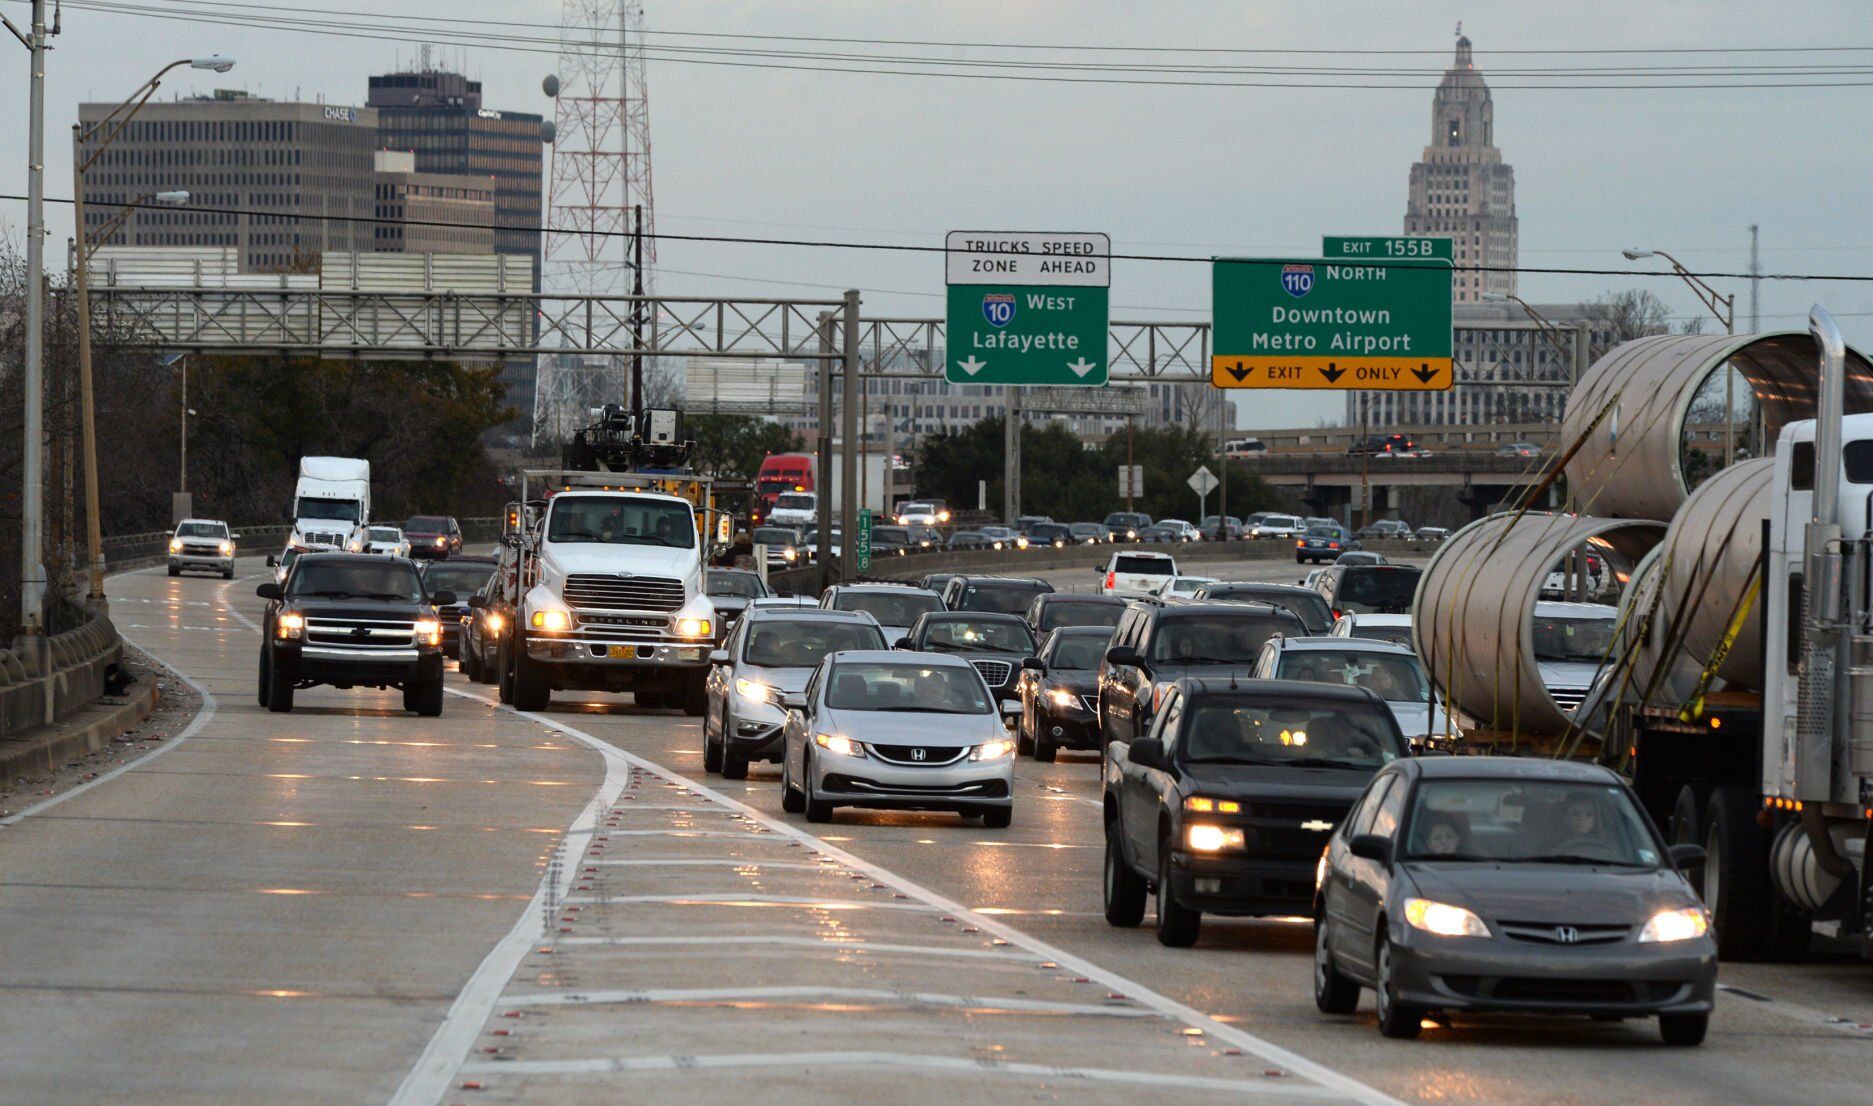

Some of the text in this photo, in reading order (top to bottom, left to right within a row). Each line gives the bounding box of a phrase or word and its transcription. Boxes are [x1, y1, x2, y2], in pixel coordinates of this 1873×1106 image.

[324, 106, 350, 121] CHASE
[965, 240, 1094, 255] TRUCKS SPEED
[1343, 240, 1433, 256] EXIT 155B
[972, 259, 1096, 274] ZONE AHEAD
[1326, 265, 1387, 280] NORTH
[1285, 274, 1311, 291] 110
[1027, 293, 1076, 310] WEST
[988, 303, 1010, 322] 10
[1272, 306, 1391, 324] Downtown
[973, 330, 1079, 353] Lafayette
[1252, 332, 1411, 354] Metro Airport
[1268, 366, 1401, 380] EXIT ONLY
[589, 617, 657, 626] STERLING
